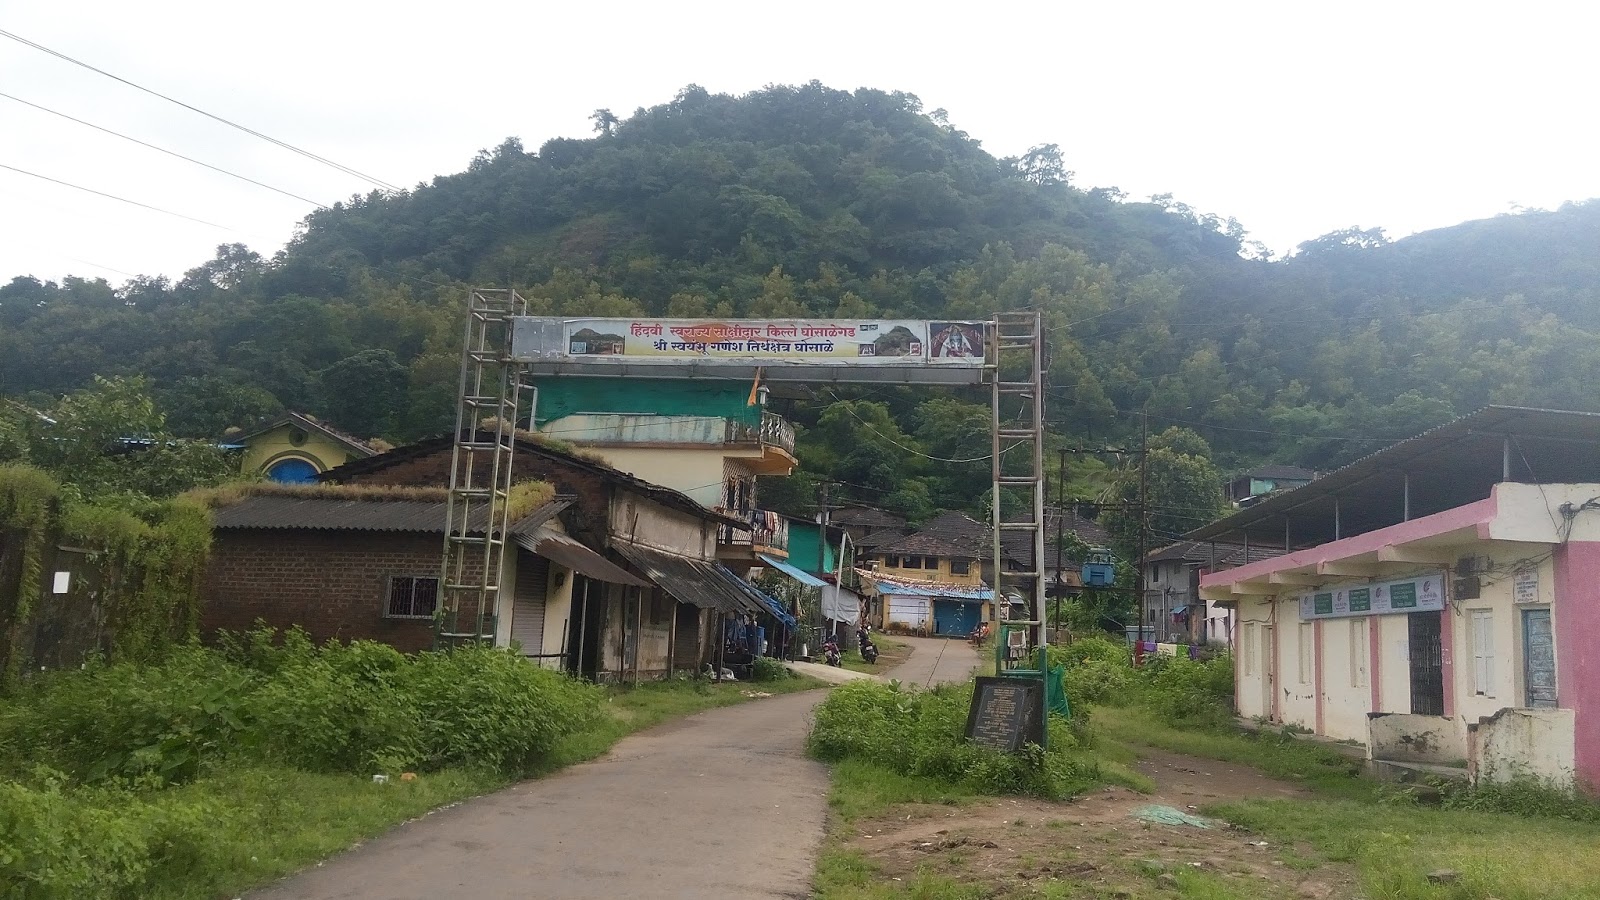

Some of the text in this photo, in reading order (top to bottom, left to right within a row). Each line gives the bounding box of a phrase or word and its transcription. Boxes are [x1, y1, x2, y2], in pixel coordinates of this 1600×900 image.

[630, 323, 856, 339] हिंदवी स्वराज्य साक्षीदार किल्ले घोसाळेगड
[653, 339, 834, 355] श्री स्वयंभू गणेश तिर्थक्षेत्र घोसाळे
